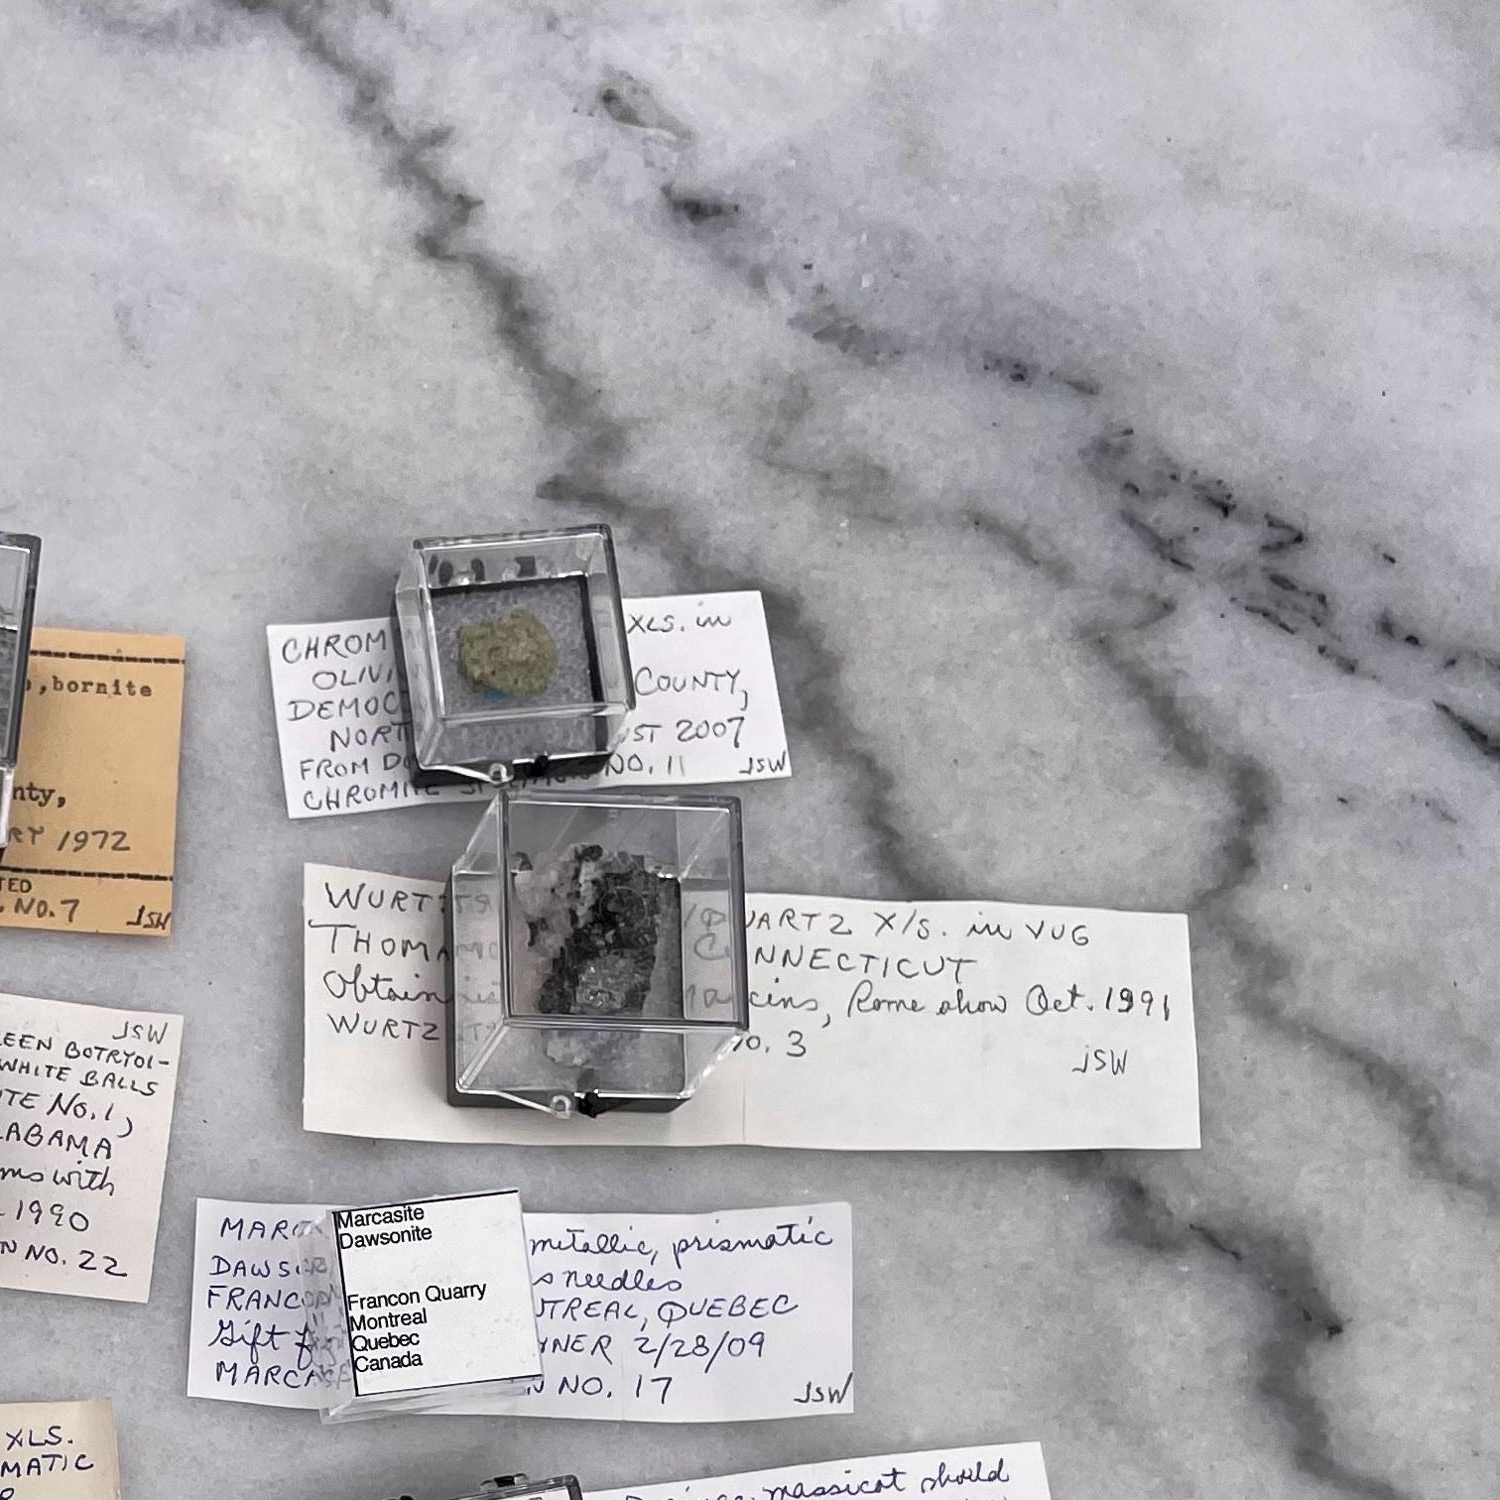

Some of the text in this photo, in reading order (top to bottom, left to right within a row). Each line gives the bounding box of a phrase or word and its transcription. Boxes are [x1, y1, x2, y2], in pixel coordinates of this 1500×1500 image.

[287, 690, 403, 722] DEMOC
[300, 716, 745, 781] FROM 2007
[330, 720, 412, 752] NORT
[13, 782, 67, 808] nty,
[57, 831, 131, 852] 1972
[61, 899, 81, 923] 7
[1025, 919, 1090, 946] VUG
[754, 944, 978, 984] NNECTICUT
[1025, 983, 1095, 1016] Oct.
[1106, 986, 1170, 1021] 1991
[112, 1020, 168, 1045] JSW
[327, 1012, 807, 1058] WURTZ 3
[80, 1070, 159, 1097] BALLS
[46, 1092, 96, 1121] NO.
[52, 1160, 115, 1196] with
[16, 1199, 89, 1232] 1990
[337, 1206, 426, 1229] Marcasite
[340, 1225, 433, 1250] Dawsonite
[25, 1243, 67, 1266] NO.
[78, 1250, 128, 1277] 22
[207, 1285, 799, 1328] FRANC QUEBEC
[347, 1283, 487, 1312] Francon Quarry
[350, 1308, 428, 1332] Montreal
[352, 1332, 421, 1352] Quebec
[354, 1351, 424, 1373] Canada
[558, 1374, 613, 1399] NO.
[635, 1374, 674, 1405] 17
[6, 1425, 75, 1451] XLS.
[920, 1458, 1011, 1494] should
